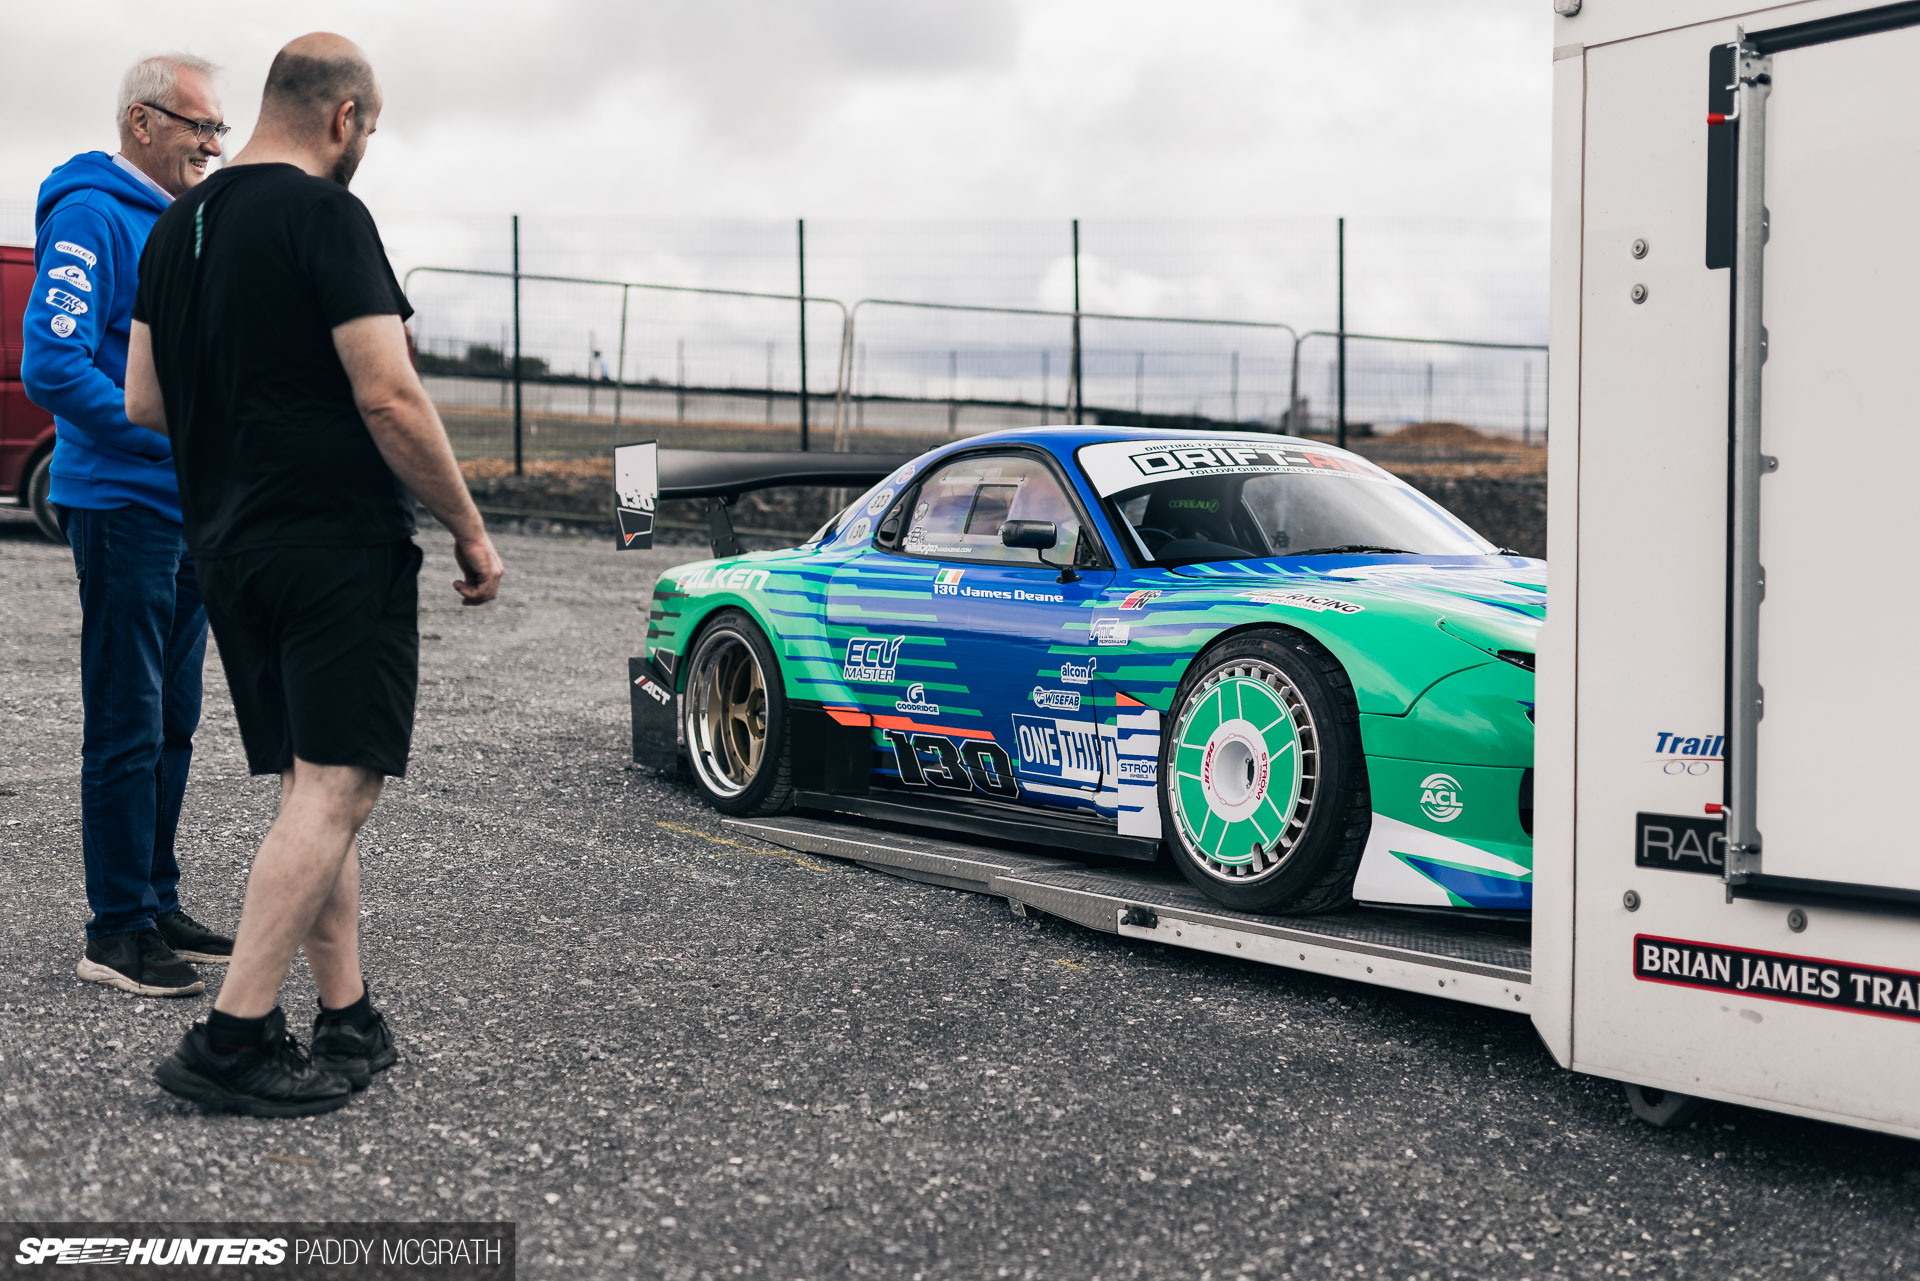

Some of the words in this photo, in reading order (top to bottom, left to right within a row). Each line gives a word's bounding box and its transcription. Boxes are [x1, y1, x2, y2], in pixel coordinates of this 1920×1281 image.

[54, 320, 69, 330] ACL
[1144, 443, 1196, 452] DRIFTING
[1190, 467, 1235, 476] FOLLOW
[1306, 467, 1326, 475] FOR
[871, 494, 890, 510] 323
[849, 524, 867, 540] 130
[675, 568, 771, 591] FALKEN
[933, 584, 958, 596] 130
[960, 586, 1012, 600] James
[1014, 589, 1064, 603] Deane
[1286, 593, 1360, 613] RACING
[846, 636, 905, 669] ECU
[844, 667, 895, 682] MASTER
[1062, 662, 1088, 678] alcon
[1045, 692, 1080, 706] WISEFAB
[897, 703, 938, 713] GOODRIDGE
[1018, 724, 1060, 767] ONE
[883, 728, 1020, 799] 130
[1420, 789, 1464, 807] ACL
[1641, 944, 1732, 983] BRIAN
[1735, 958, 1841, 999] JAMES
